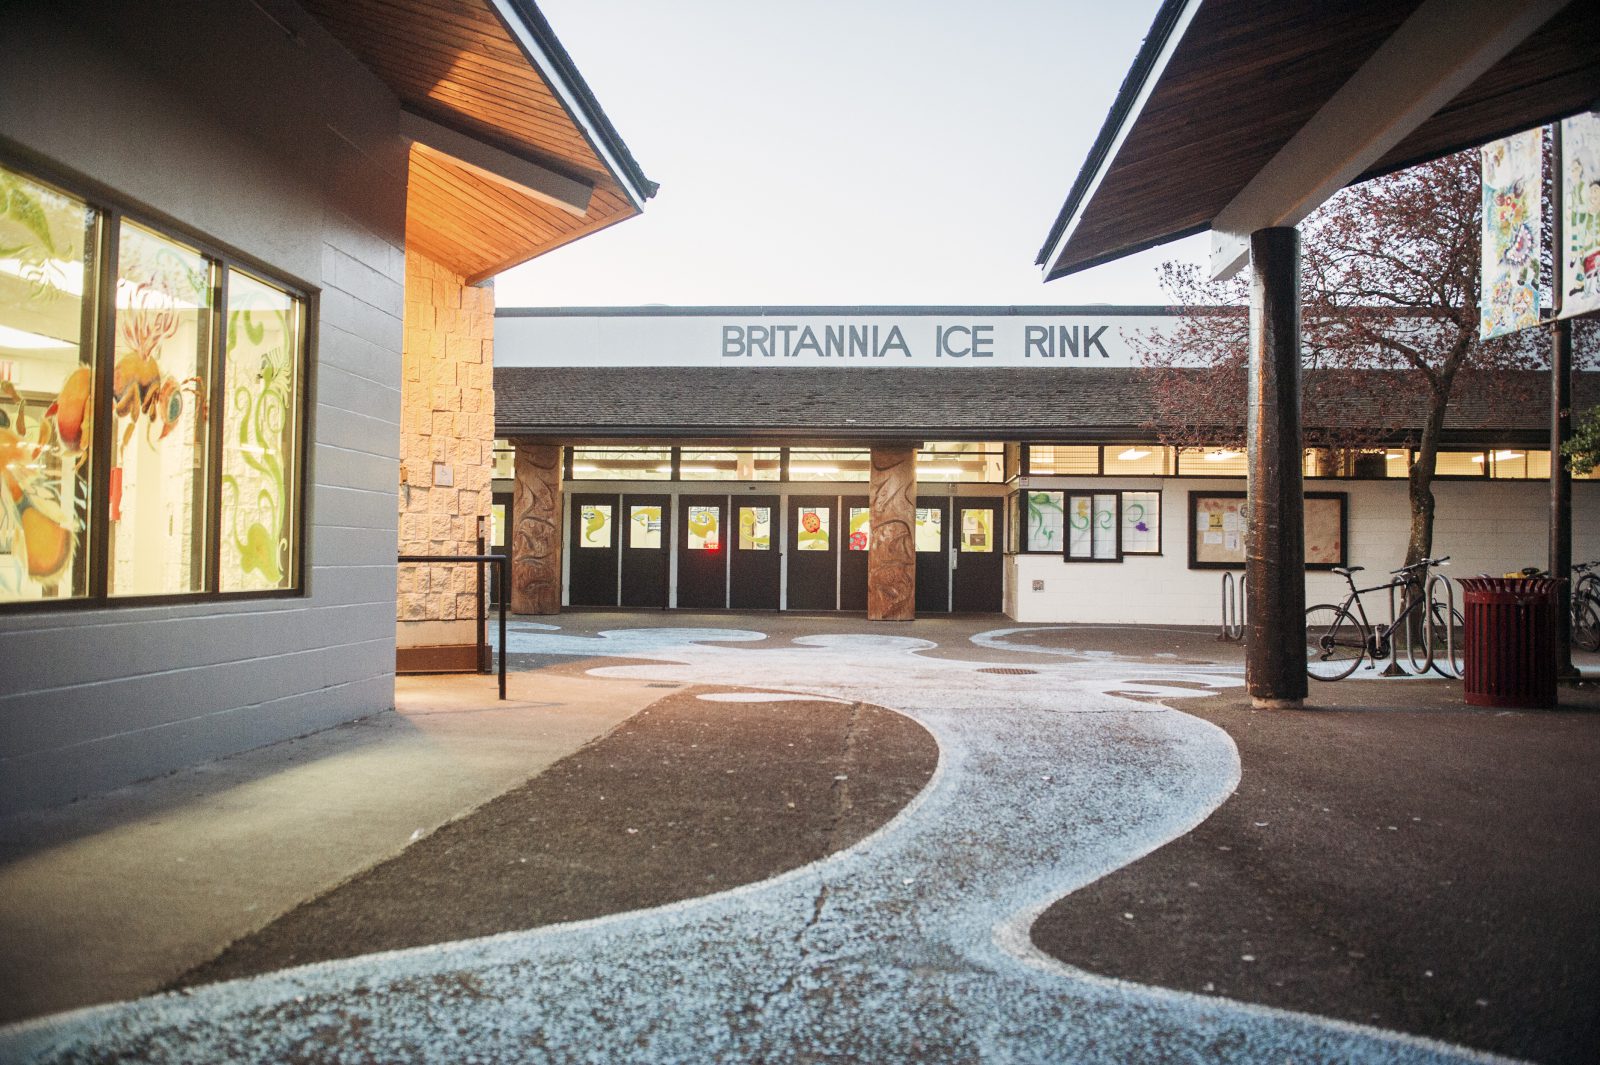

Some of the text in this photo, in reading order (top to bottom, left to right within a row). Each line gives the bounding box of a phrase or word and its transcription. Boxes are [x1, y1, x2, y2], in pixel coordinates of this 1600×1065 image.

[721, 325, 1110, 357] BRITANNIA ICE RINK
